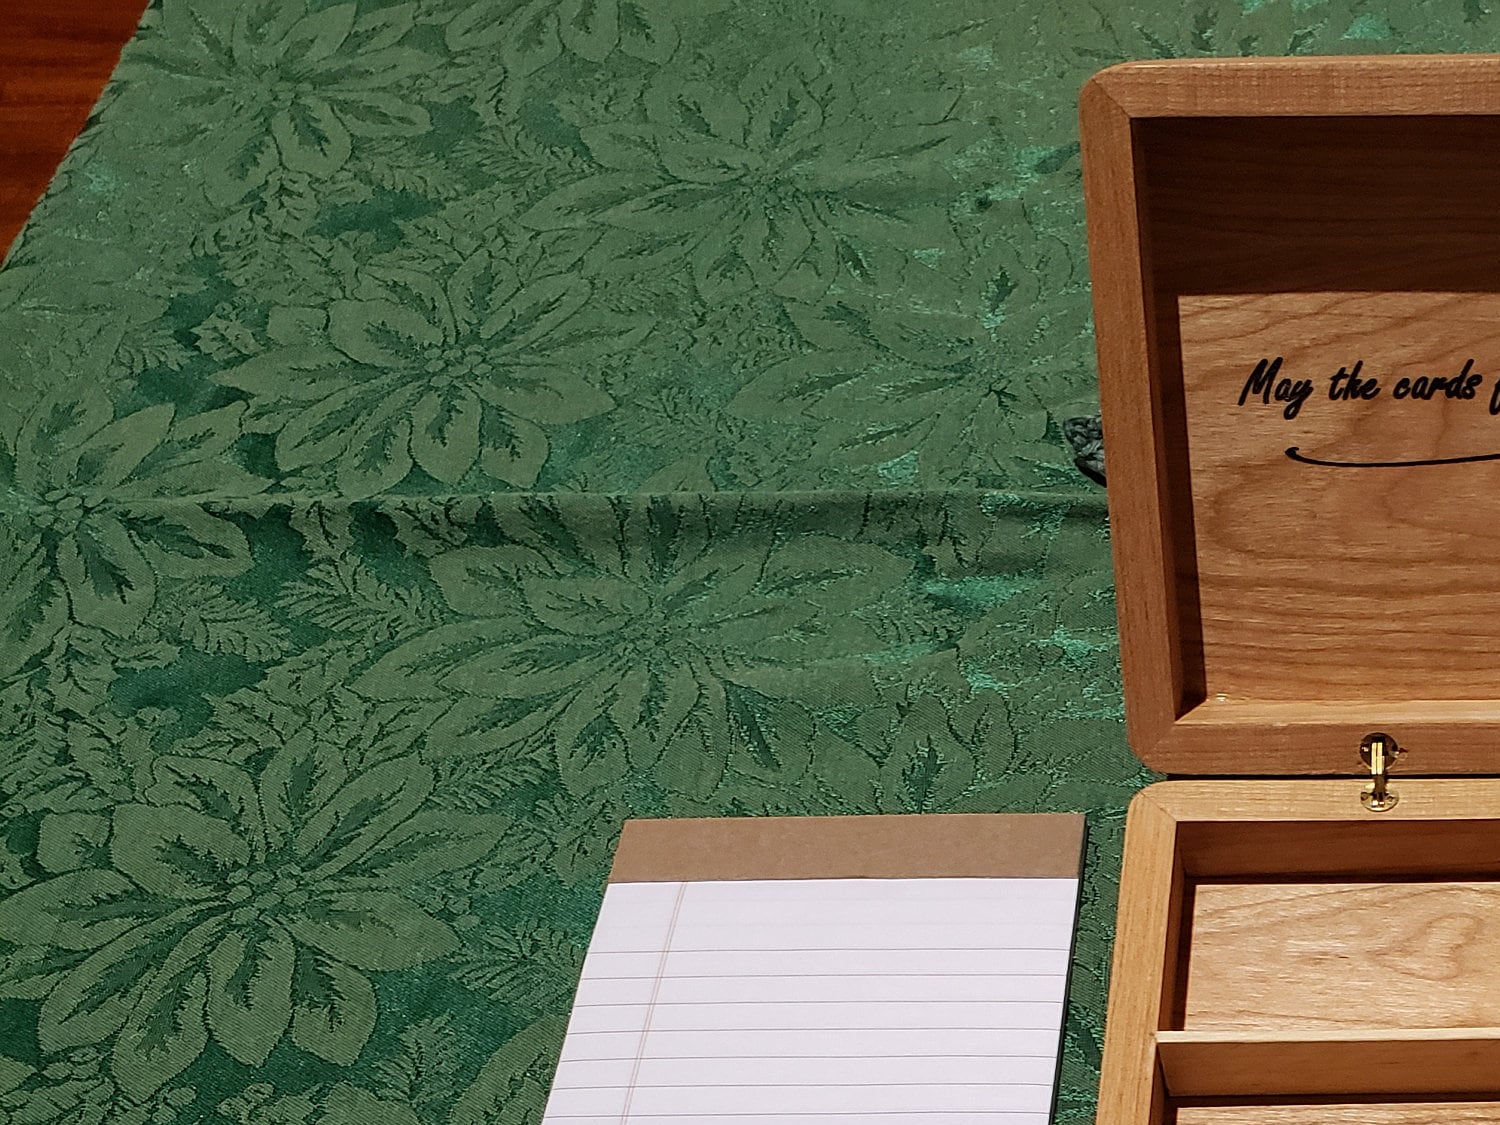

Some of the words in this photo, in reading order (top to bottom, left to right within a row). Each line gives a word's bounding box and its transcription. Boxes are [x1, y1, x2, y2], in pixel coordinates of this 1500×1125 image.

[1238, 356, 1314, 420] May
[1328, 360, 1381, 401] the
[1392, 358, 1483, 401] cards
